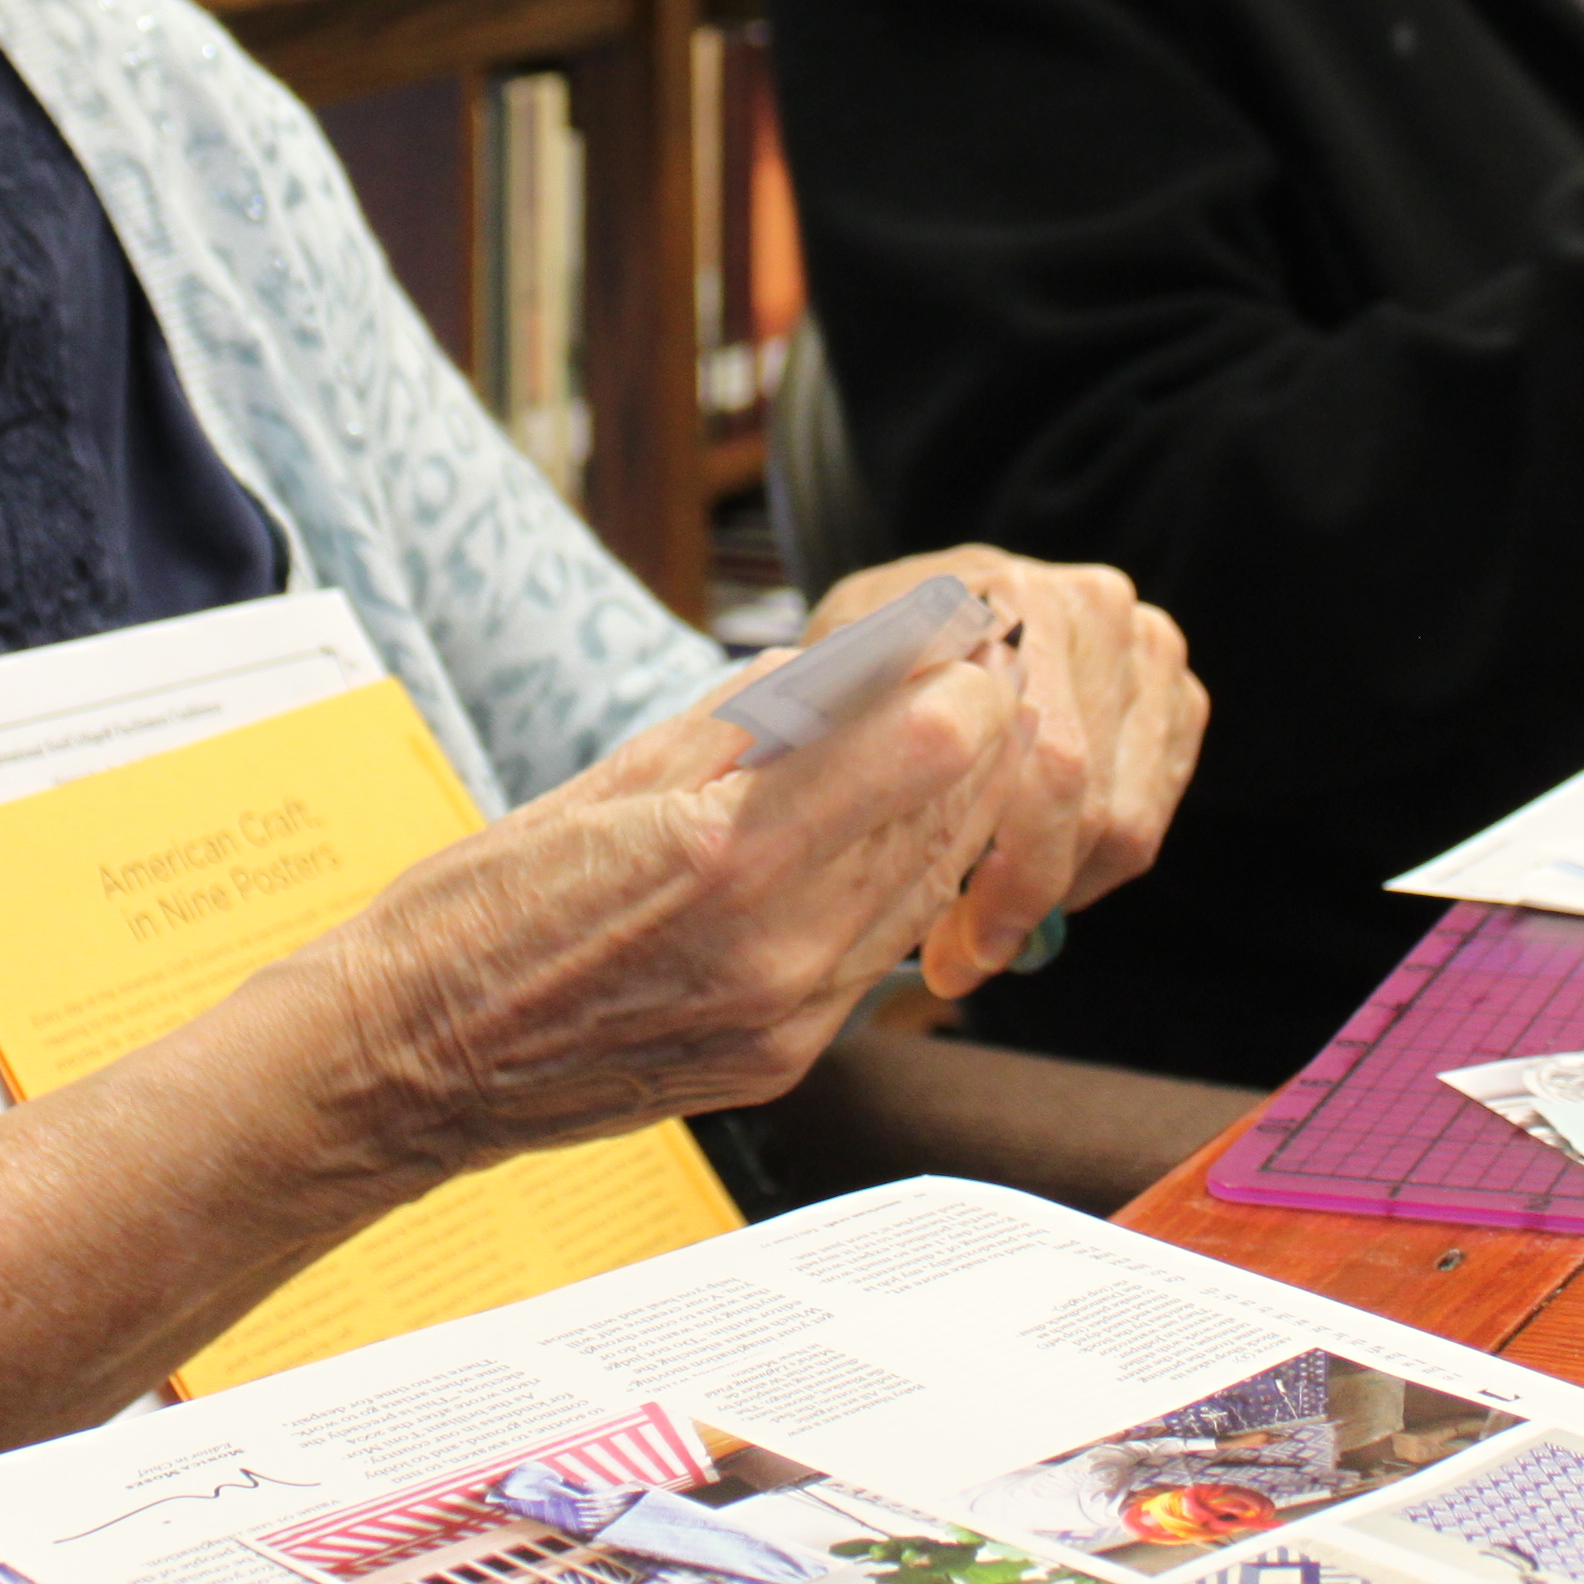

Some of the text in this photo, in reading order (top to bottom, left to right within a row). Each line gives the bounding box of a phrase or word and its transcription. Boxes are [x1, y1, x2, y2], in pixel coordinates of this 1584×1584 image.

[100, 833, 235, 896] American
[127, 848, 339, 941] in Nine Posters
[685, 1294, 723, 1308] Your
[741, 1288, 771, 1300] that
[538, 1277, 741, 1346] help you heal and will almost
[696, 1299, 739, 1315] wants
[760, 1300, 802, 1318] editor
[627, 1307, 682, 1328] creative
[770, 1307, 822, 1327] Which
[811, 1312, 835, 1324] get
[597, 1327, 623, 1339] self
[600, 1294, 786, 1361] anything you want to do or
[641, 1320, 678, 1335] come
[724, 1325, 770, 1343] means
[778, 1321, 811, 1338] your
[566, 1337, 595, 1349] will
[579, 1333, 638, 1355] through
[646, 1346, 672, 1357] not
[656, 1342, 722, 1366] silencing
[690, 1336, 777, 1367] imagination
[450, 1359, 497, 1375] There
[604, 1354, 645, 1371] judge
[635, 1363, 659, 1374] the
[477, 1365, 510, 1378] time
[411, 1379, 431, 1387] no
[431, 1377, 473, 1393] when
[376, 1386, 410, 1399] time
[381, 1391, 429, 1409] artists
[513, 1392, 534, 1402] As
[550, 1392, 574, 1403] for
[350, 1398, 374, 1408] for
[489, 1401, 513, 1411] the
[340, 1414, 359, 1422] to
[346, 1378, 541, 1445] rison wrote after the 2004
[360, 1406, 379, 1416] go
[480, 1401, 549, 1426] kindness
[523, 1400, 589, 1424] common
[587, 1407, 605, 1415] to
[328, 1412, 397, 1439] precisely
[426, 1410, 488, 1433] brilliant
[462, 1424, 477, 1432] in
[301, 1438, 326, 1448] the
[383, 1432, 425, 1446] Toni
[435, 1431, 460, 1443] our
[192, 1442, 232, 1458] Editor
[430, 1444, 459, 1458] and
[411, 1455, 430, 1463] to
[138, 1462, 173, 1477] Chief
[364, 1461, 411, 1480] lobby
[425, 1464, 442, 1472] to
[391, 1470, 423, 1484] find
[179, 1547, 236, 1570] people
